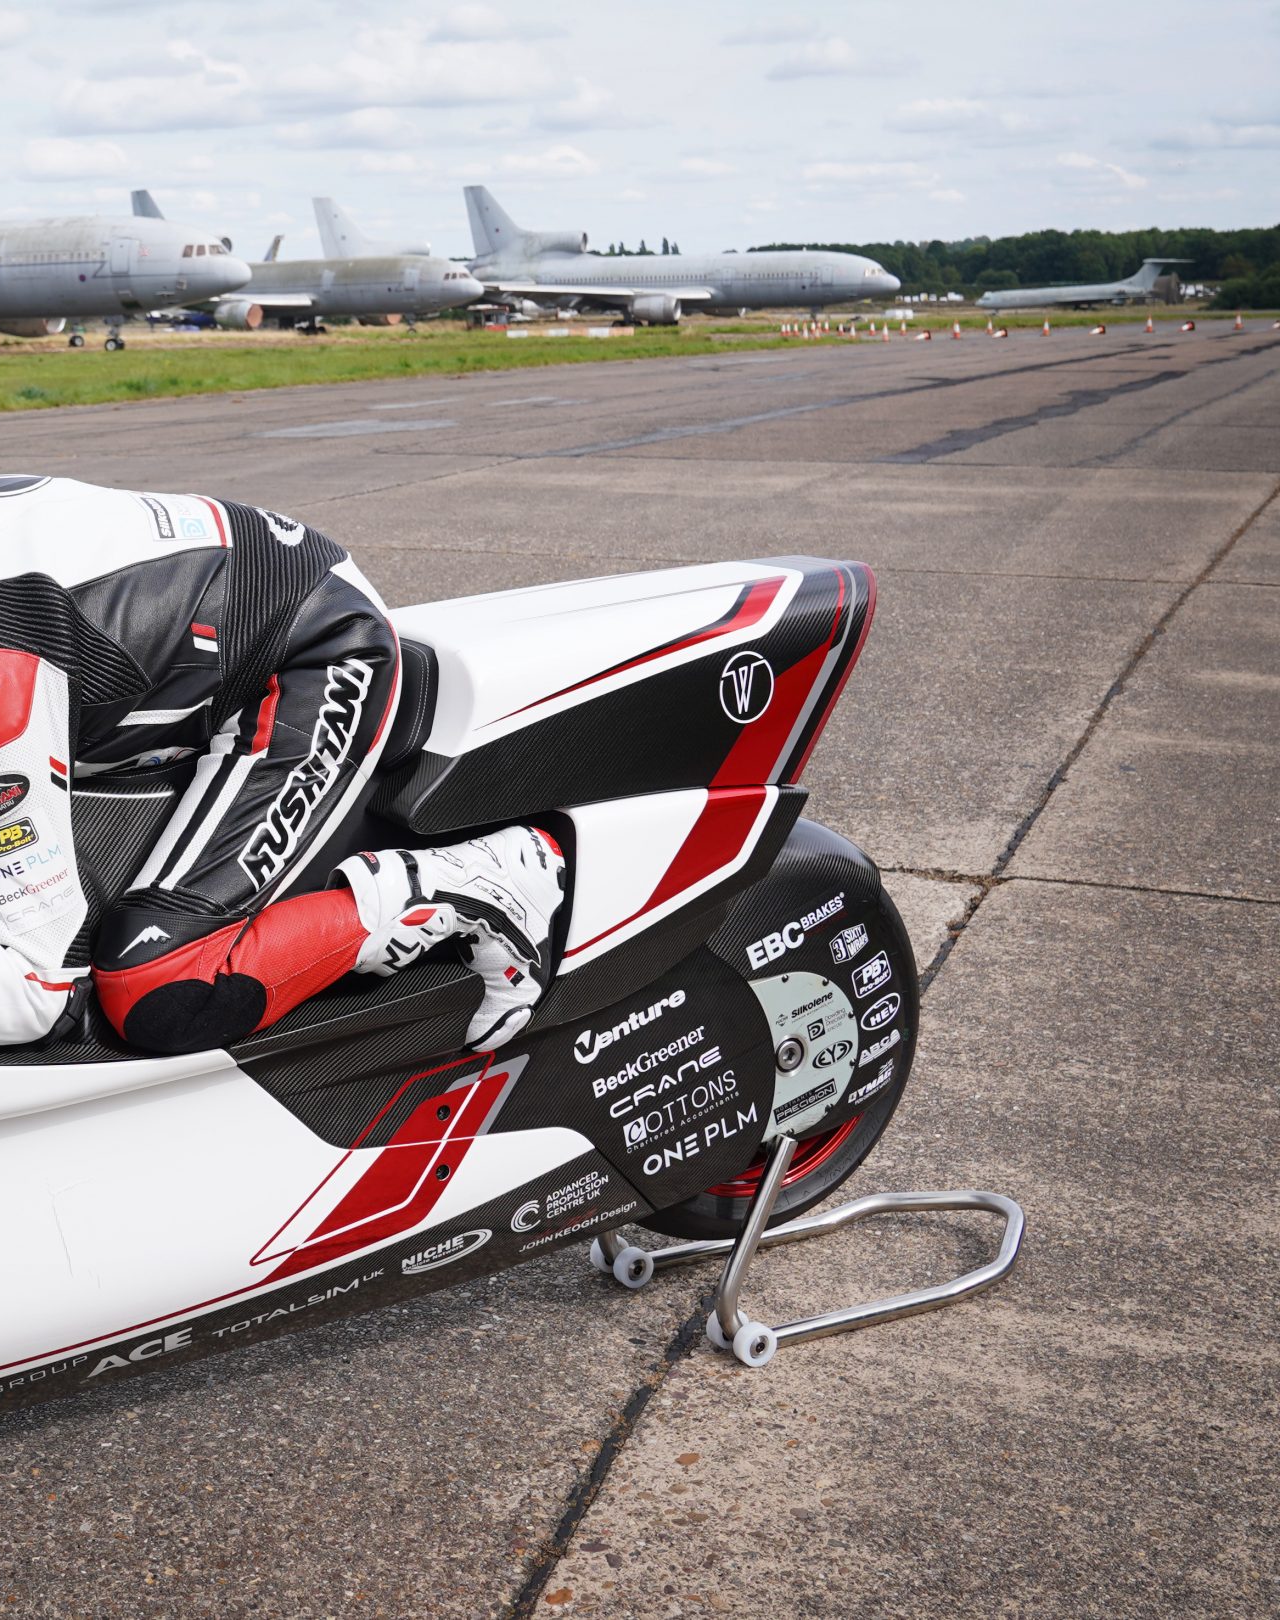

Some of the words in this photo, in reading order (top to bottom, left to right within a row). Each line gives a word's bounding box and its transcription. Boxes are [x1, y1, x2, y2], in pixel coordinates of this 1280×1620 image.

[26, 844, 62, 870] PLM
[746, 922, 804, 970] EBC
[834, 939, 847, 960] 3
[862, 958, 882, 984] PB
[792, 992, 833, 1018] Silkolene
[870, 1004, 897, 1026] HEL
[574, 990, 686, 1064] Venture
[592, 1025, 704, 1098] BeckGreener
[610, 1046, 722, 1118] CRANE
[848, 1064, 893, 1104] DYMAG
[626, 1125, 676, 1154] Chartered
[680, 1090, 740, 1126] Accountants
[776, 1086, 834, 1120] PRECISION
[642, 1132, 700, 1176] ONE
[704, 1102, 758, 1147] PLM
[546, 1171, 599, 1203] ADVANCED
[546, 1175, 608, 1212] PROPULSION
[547, 1197, 584, 1218] CENTRE
[587, 1188, 600, 1202] UK
[519, 1236, 554, 1252] JOHN
[554, 1216, 599, 1242] KEOGH
[600, 1201, 637, 1222] Design
[402, 1234, 464, 1270] NICHE
[212, 1278, 360, 1338] TOTALSIM
[363, 1268, 384, 1282] UK
[87, 1327, 192, 1378] ACE
